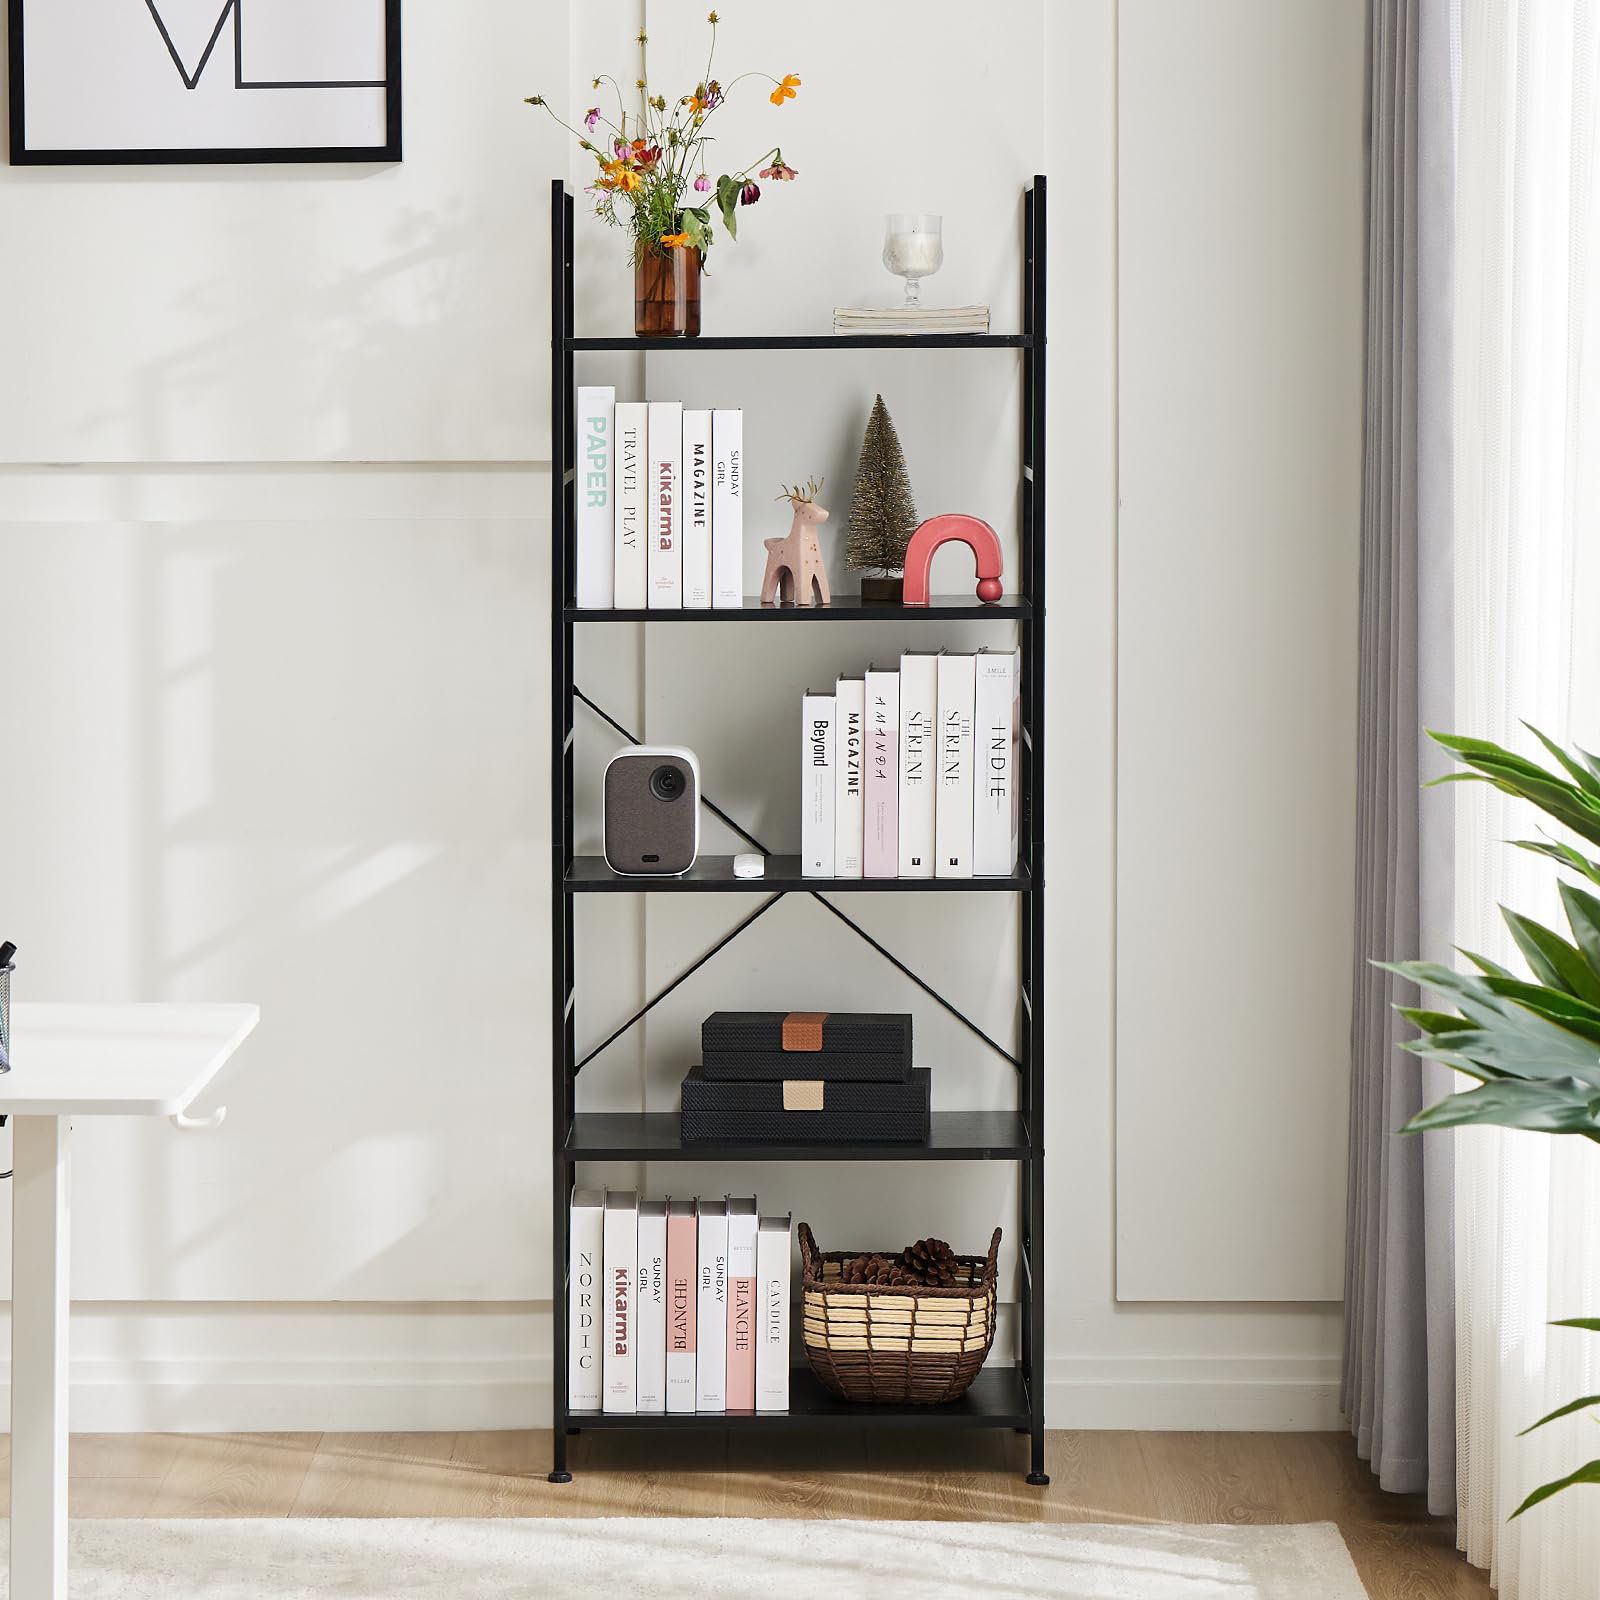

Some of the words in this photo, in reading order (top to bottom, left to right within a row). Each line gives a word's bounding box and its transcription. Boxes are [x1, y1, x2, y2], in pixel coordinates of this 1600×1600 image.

[586, 416, 608, 509] PAPER
[624, 427, 637, 495] TRAVEL
[693, 443, 706, 528] MAGAZINE
[717, 461, 726, 487] GIRL
[730, 450, 739, 497] SUNDAY
[623, 506, 636, 549] PLAY
[810, 719, 829, 767] Beyond
[847, 712, 860, 797] MAGAZINE
[874, 695, 888, 780] AMANDA
[906, 710, 923, 787] SERENE
[943, 710, 961, 787] SERENE
[990, 726, 1007, 799] INDIE
[578, 1251, 594, 1370] NORDIC
[639, 1267, 648, 1293] GIRL
[652, 1256, 662, 1304] SUNDAY
[673, 1277, 689, 1351] BLANCHE
[702, 1266, 711, 1292] GIRL
[715, 1255, 725, 1303] SUNDAY
[767, 1279, 781, 1344] CANDICE
[735, 1279, 750, 1352] BLANCHE
